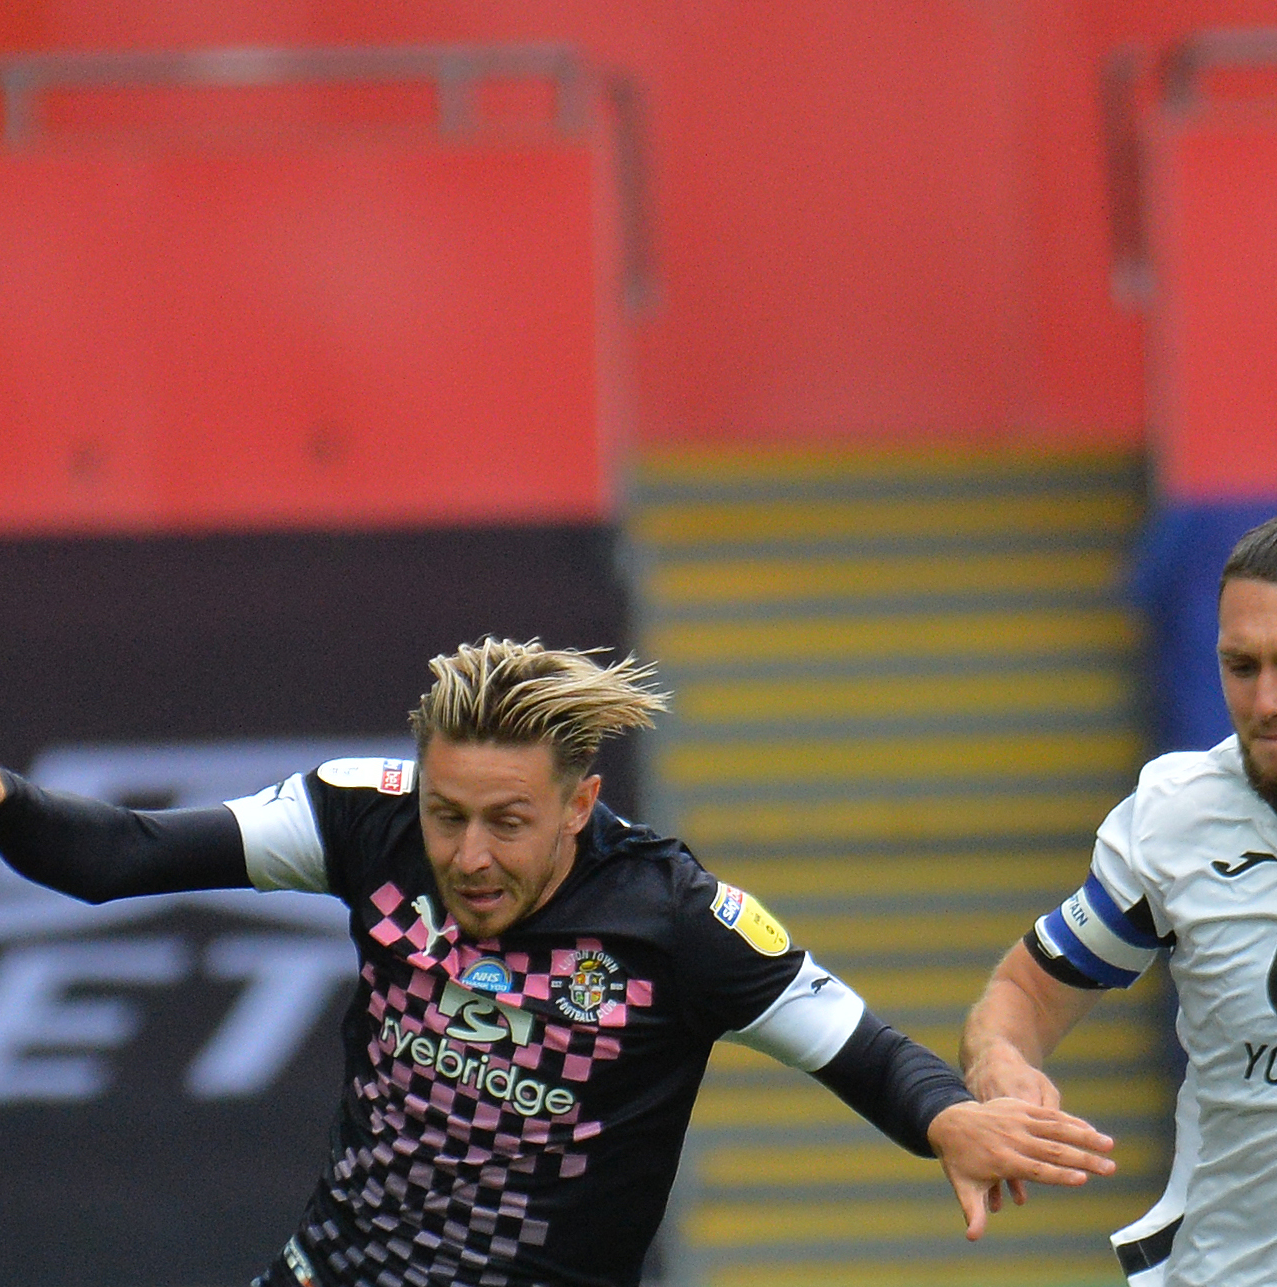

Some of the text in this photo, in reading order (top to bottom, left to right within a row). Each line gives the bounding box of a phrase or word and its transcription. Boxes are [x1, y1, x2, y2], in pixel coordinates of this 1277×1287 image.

[722, 898, 741, 921] sky
[1070, 893, 1089, 927] TAIN
[559, 951, 619, 974] LUTON TOWN
[473, 972, 500, 983] NHS
[489, 983, 507, 993] YOU
[555, 997, 617, 1022] FOOTBALL CLUB
[380, 1016, 573, 1116] ryebridge
